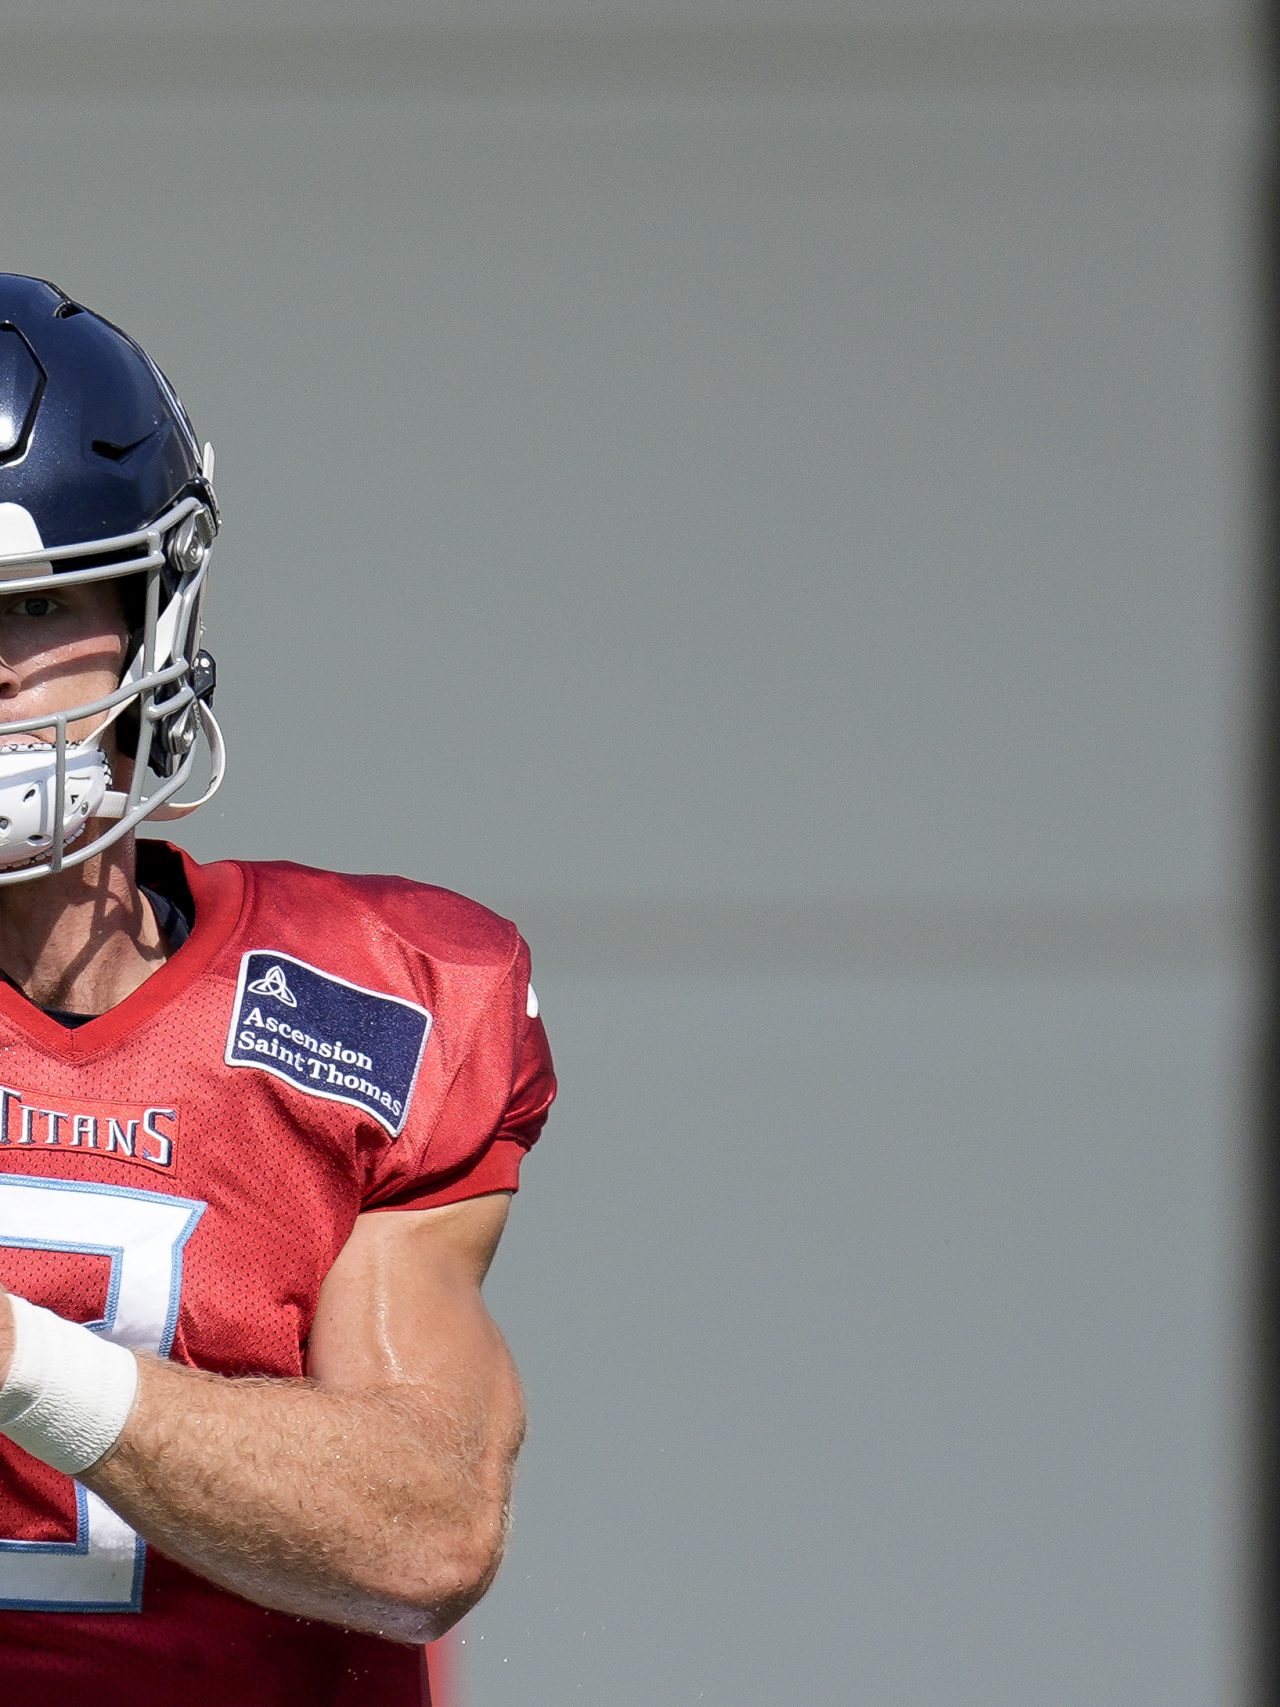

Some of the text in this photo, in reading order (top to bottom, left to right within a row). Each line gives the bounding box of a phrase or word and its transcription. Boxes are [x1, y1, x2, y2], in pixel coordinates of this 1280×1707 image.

[238, 1030, 403, 1117] Saint Thomas
[243, 1007, 373, 1071] Ascension
